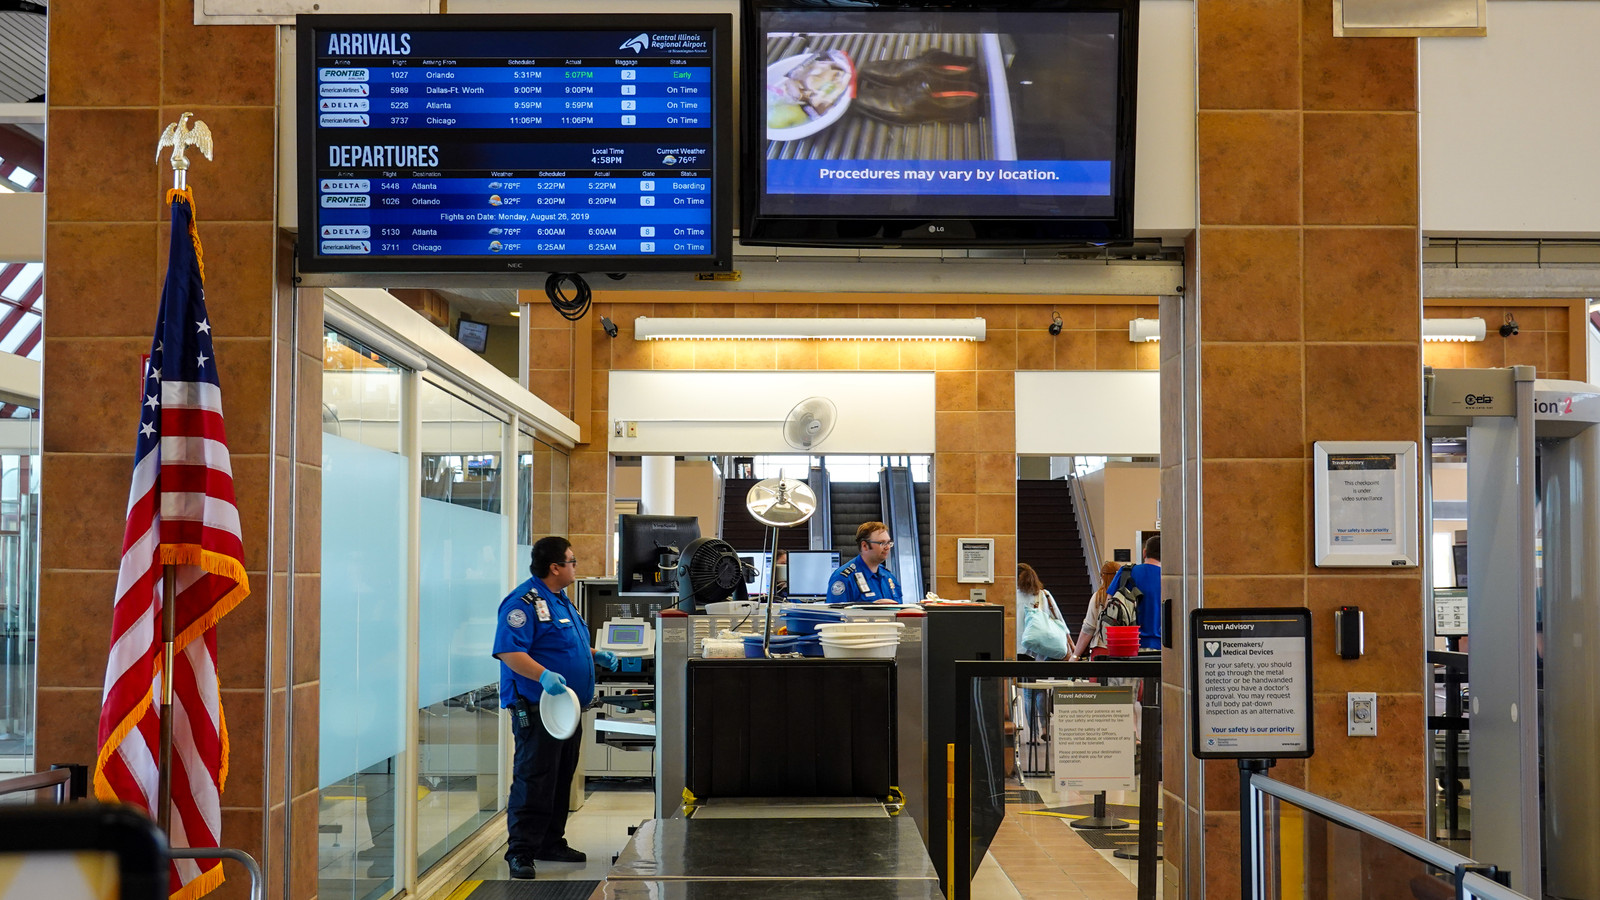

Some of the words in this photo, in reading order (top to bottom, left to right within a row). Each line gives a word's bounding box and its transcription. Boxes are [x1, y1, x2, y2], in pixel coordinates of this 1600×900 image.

[328, 33, 410, 55] ARRIVALS
[330, 146, 438, 167] DEPARTURES
[820, 168, 900, 179] Procedures
[904, 170, 935, 182] may
[940, 170, 972, 182] vary
[976, 168, 995, 182] by
[999, 169, 1059, 180] location.
[1564, 397, 1573, 413] 2
